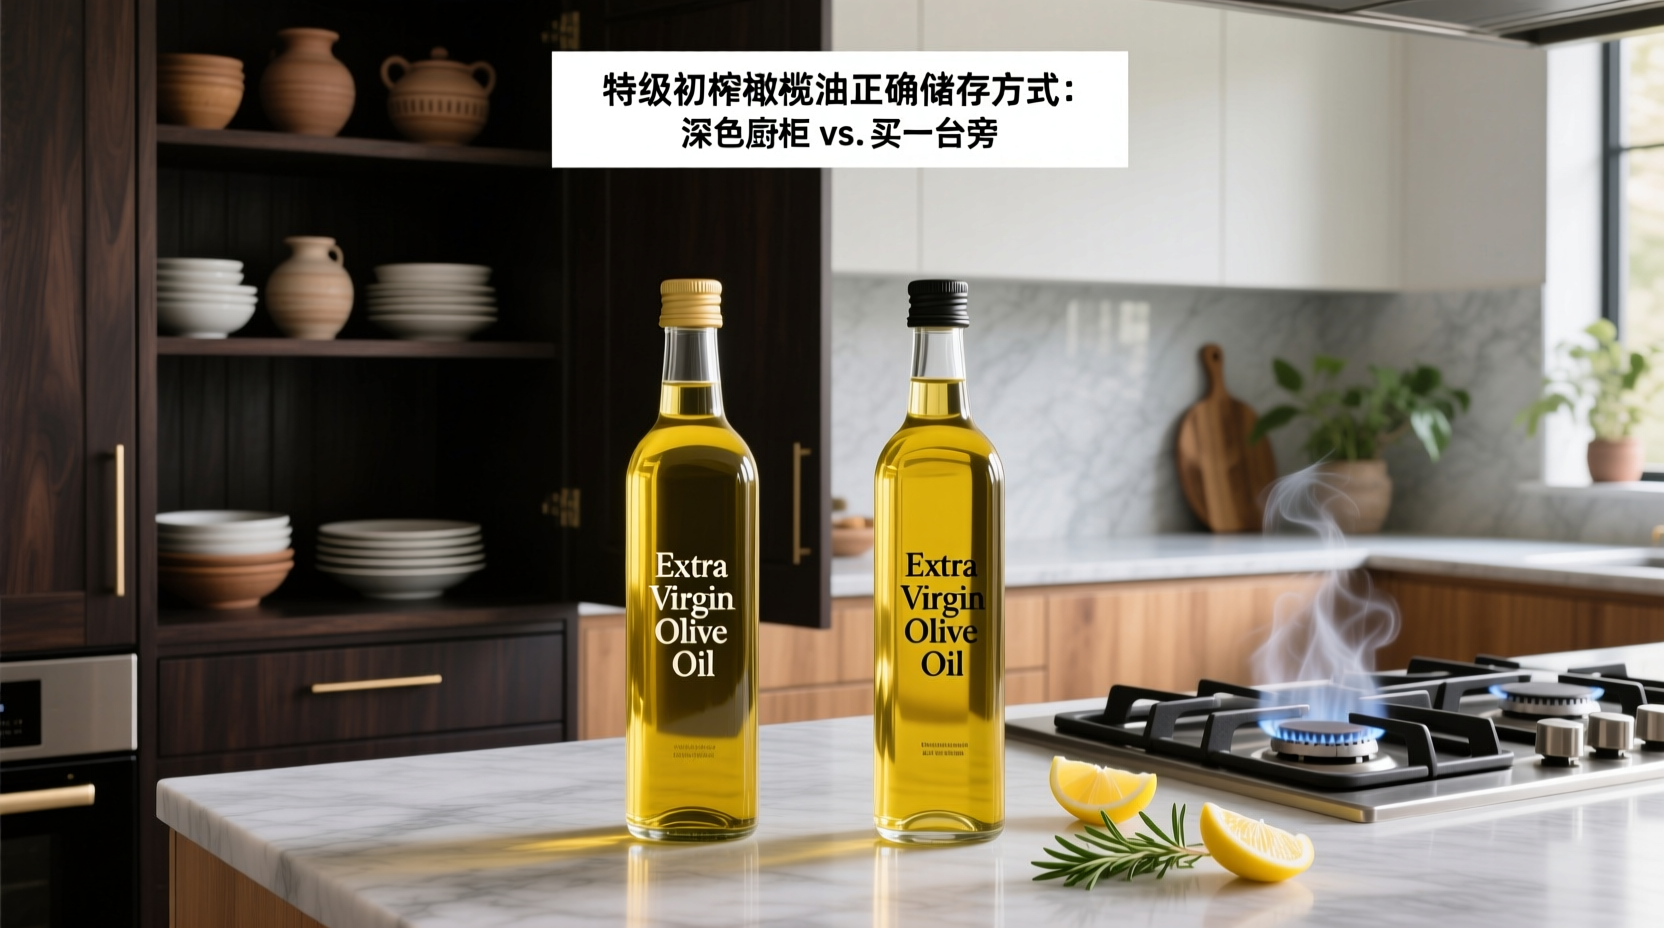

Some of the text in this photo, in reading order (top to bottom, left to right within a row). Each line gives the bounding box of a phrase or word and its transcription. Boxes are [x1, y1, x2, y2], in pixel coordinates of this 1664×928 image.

[655, 552, 728, 578] Extra
[905, 552, 977, 578] Extra
[649, 585, 736, 618] Virgin
[901, 585, 985, 617] Virgin
[655, 618, 728, 644] Olive
[904, 618, 978, 644] Olive
[672, 650, 715, 677] Oil
[921, 650, 964, 677] Oil
